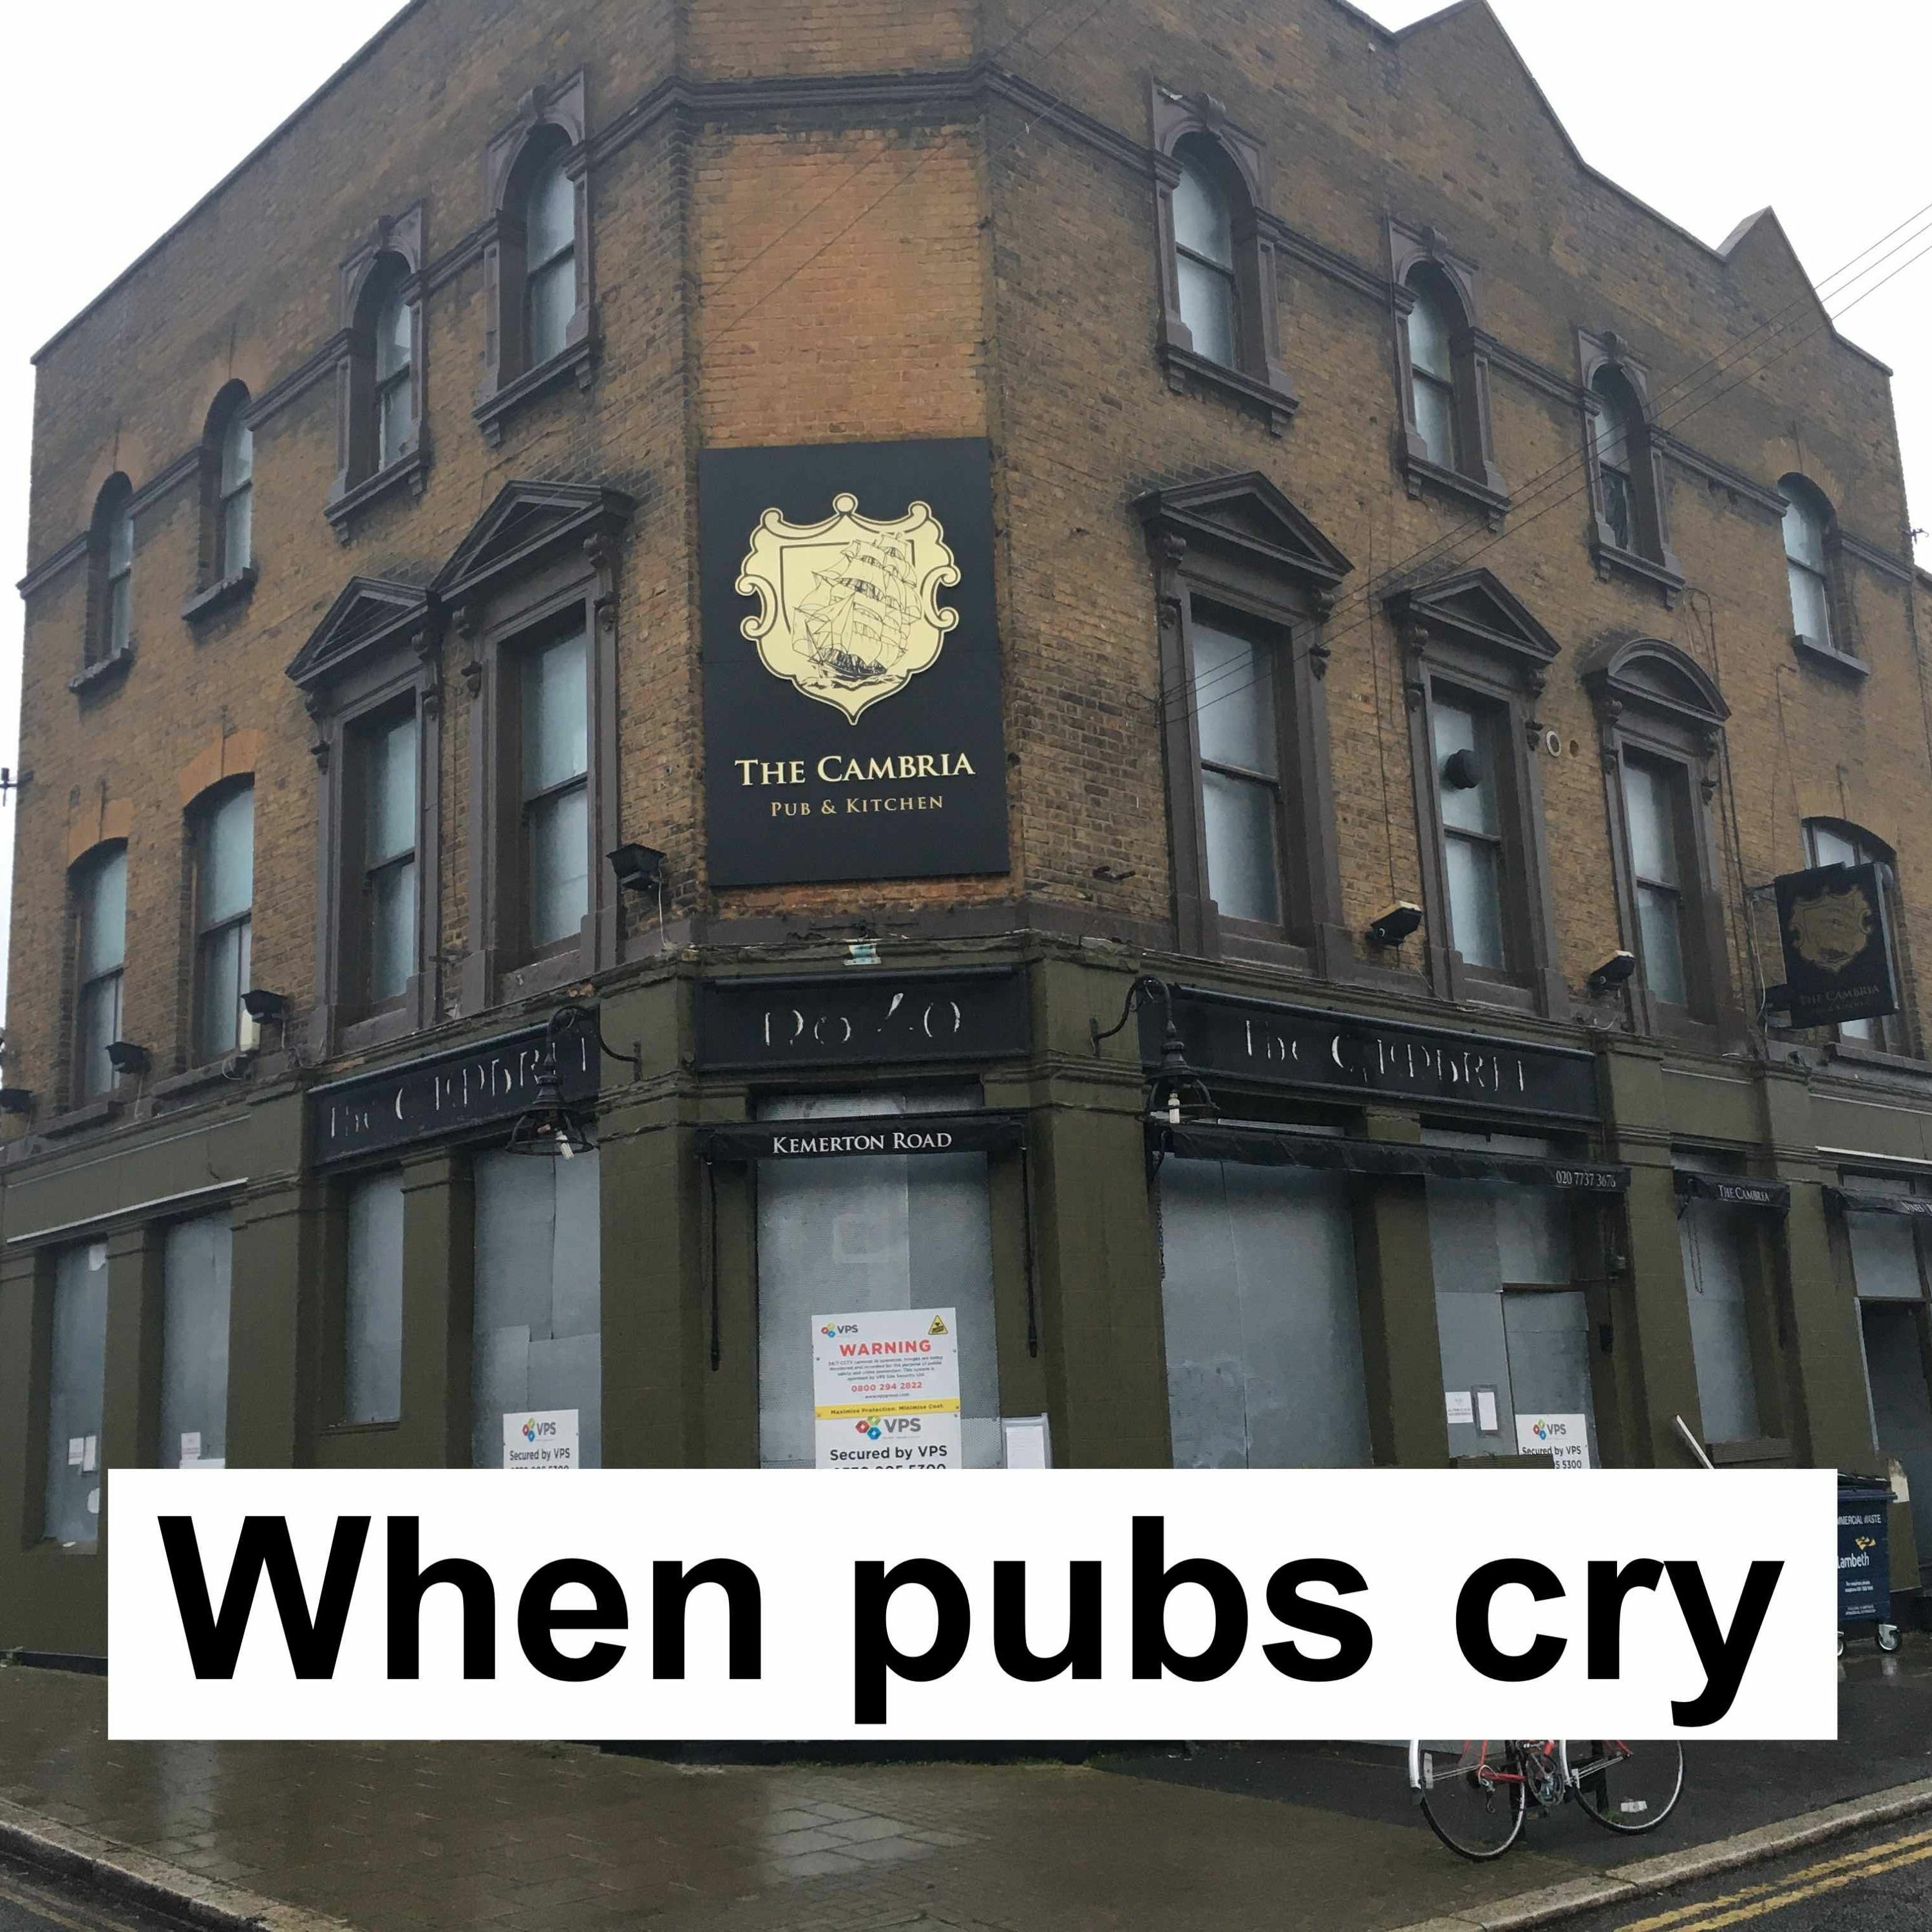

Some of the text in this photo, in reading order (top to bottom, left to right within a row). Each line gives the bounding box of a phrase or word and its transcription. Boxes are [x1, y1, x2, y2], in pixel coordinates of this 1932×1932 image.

[735, 752, 976, 786] THE CAMBRIA
[770, 795, 943, 817] PUB & KITCHEN
[773, 1132, 952, 1154] KEMERTON ROAD
[1556, 1170, 1572, 1184] 020
[1574, 1172, 1594, 1186] 7737
[1718, 1184, 1736, 1198] THE
[837, 1324, 858, 1334] VPS
[839, 1340, 931, 1356] WARNING
[851, 1384, 876, 1392] 0800
[536, 1422, 556, 1435] VPS
[884, 1417, 921, 1433] VPS
[1547, 1423, 1566, 1435] VPS
[509, 1448, 571, 1461] Secured by VPS
[830, 1445, 947, 1461] Secured by VPS
[1522, 1445, 1581, 1456] Secured by VPS
